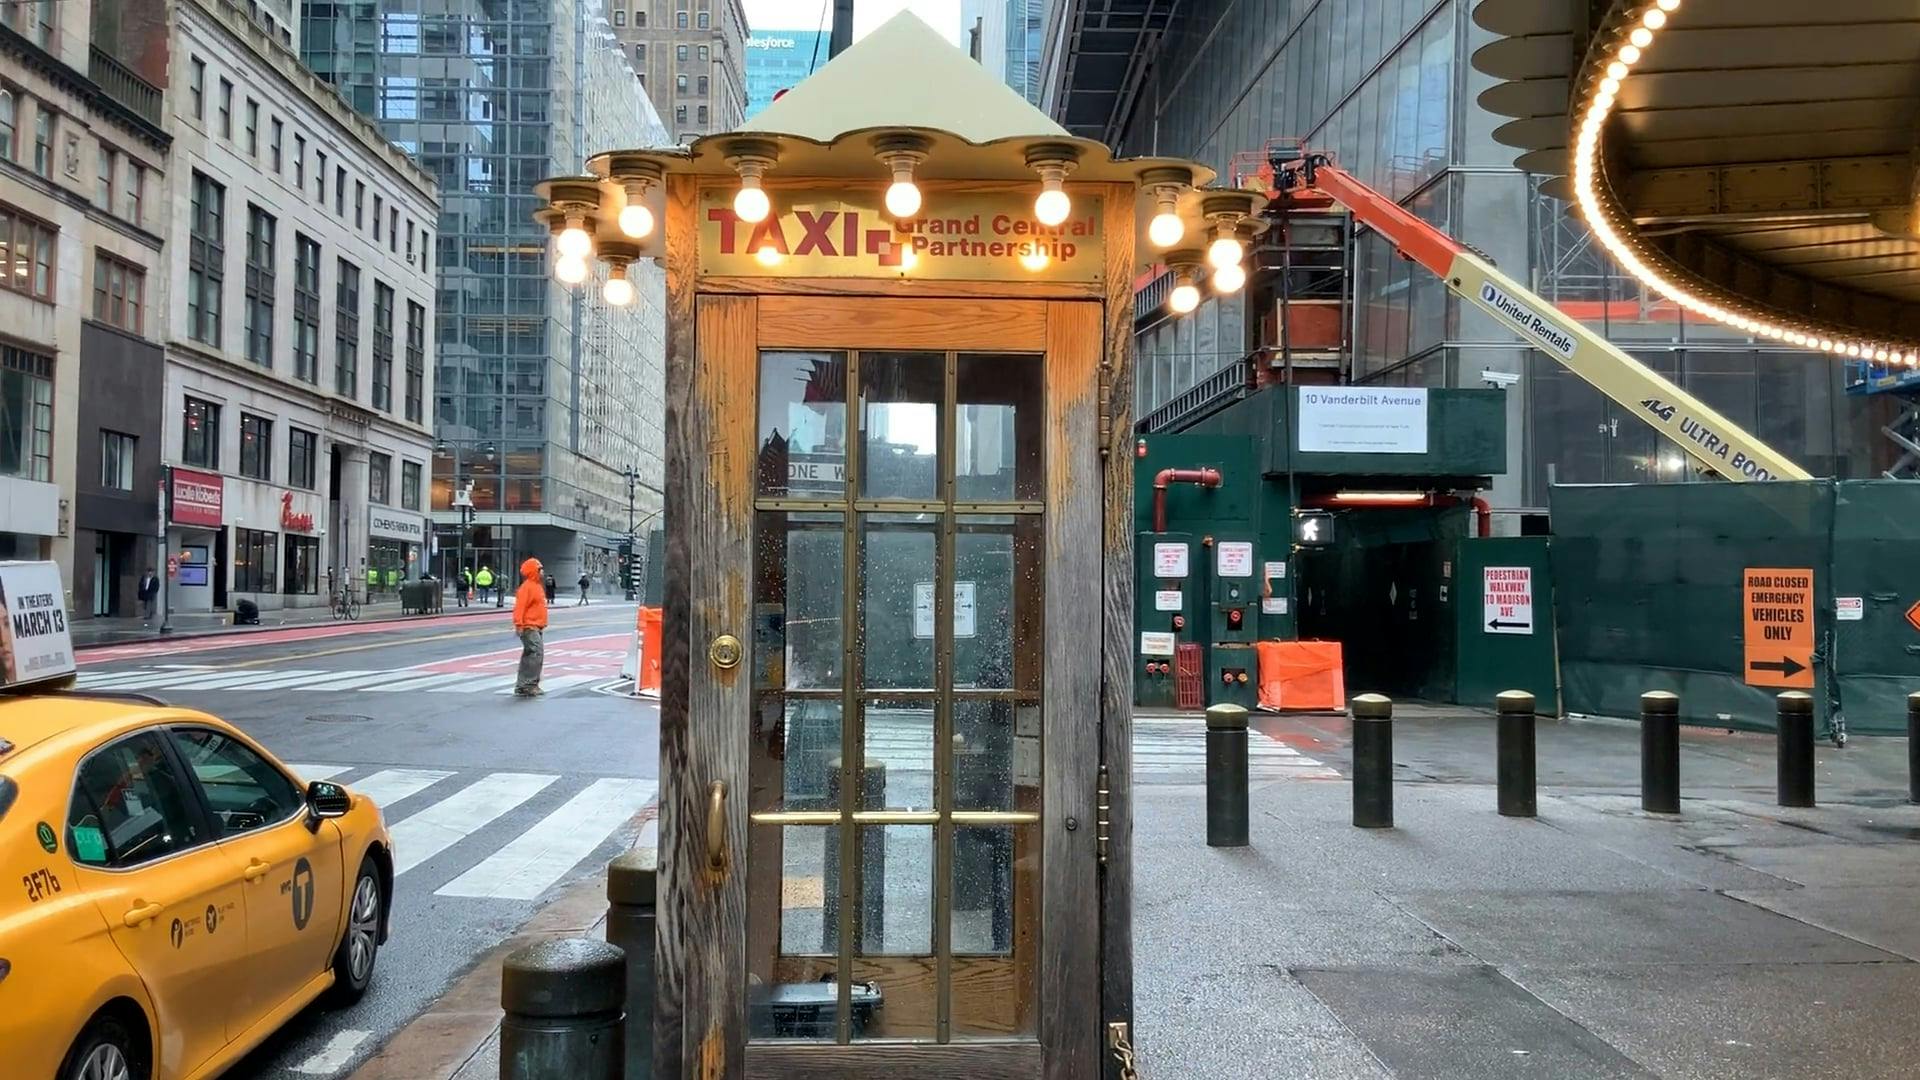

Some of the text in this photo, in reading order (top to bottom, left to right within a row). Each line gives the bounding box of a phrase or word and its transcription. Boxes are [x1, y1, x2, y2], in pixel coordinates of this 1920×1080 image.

[708, 208, 858, 256] TAXI
[894, 215, 980, 235] Grand
[912, 236, 1076, 261] Partnership
[1495, 294, 1571, 352] United Rentals
[1305, 394, 1421, 406] 10 Vanderbilt Avenue
[1680, 417, 1730, 459] ULTRA
[1731, 452, 1778, 480] BOO
[1486, 570, 1529, 580] PEDESTRIAN
[1490, 582, 1525, 592] WALKWAY
[1748, 577, 1808, 588] ROAD CLOSED
[17, 593, 53, 610] IN THEATERS
[1486, 594, 1530, 605] TO MADISON
[1751, 592, 1805, 604] EMERGENCY
[1752, 608, 1804, 622] VEHICLES
[13, 609, 64, 639] MARCH 13
[1764, 626, 1792, 640] ONLY
